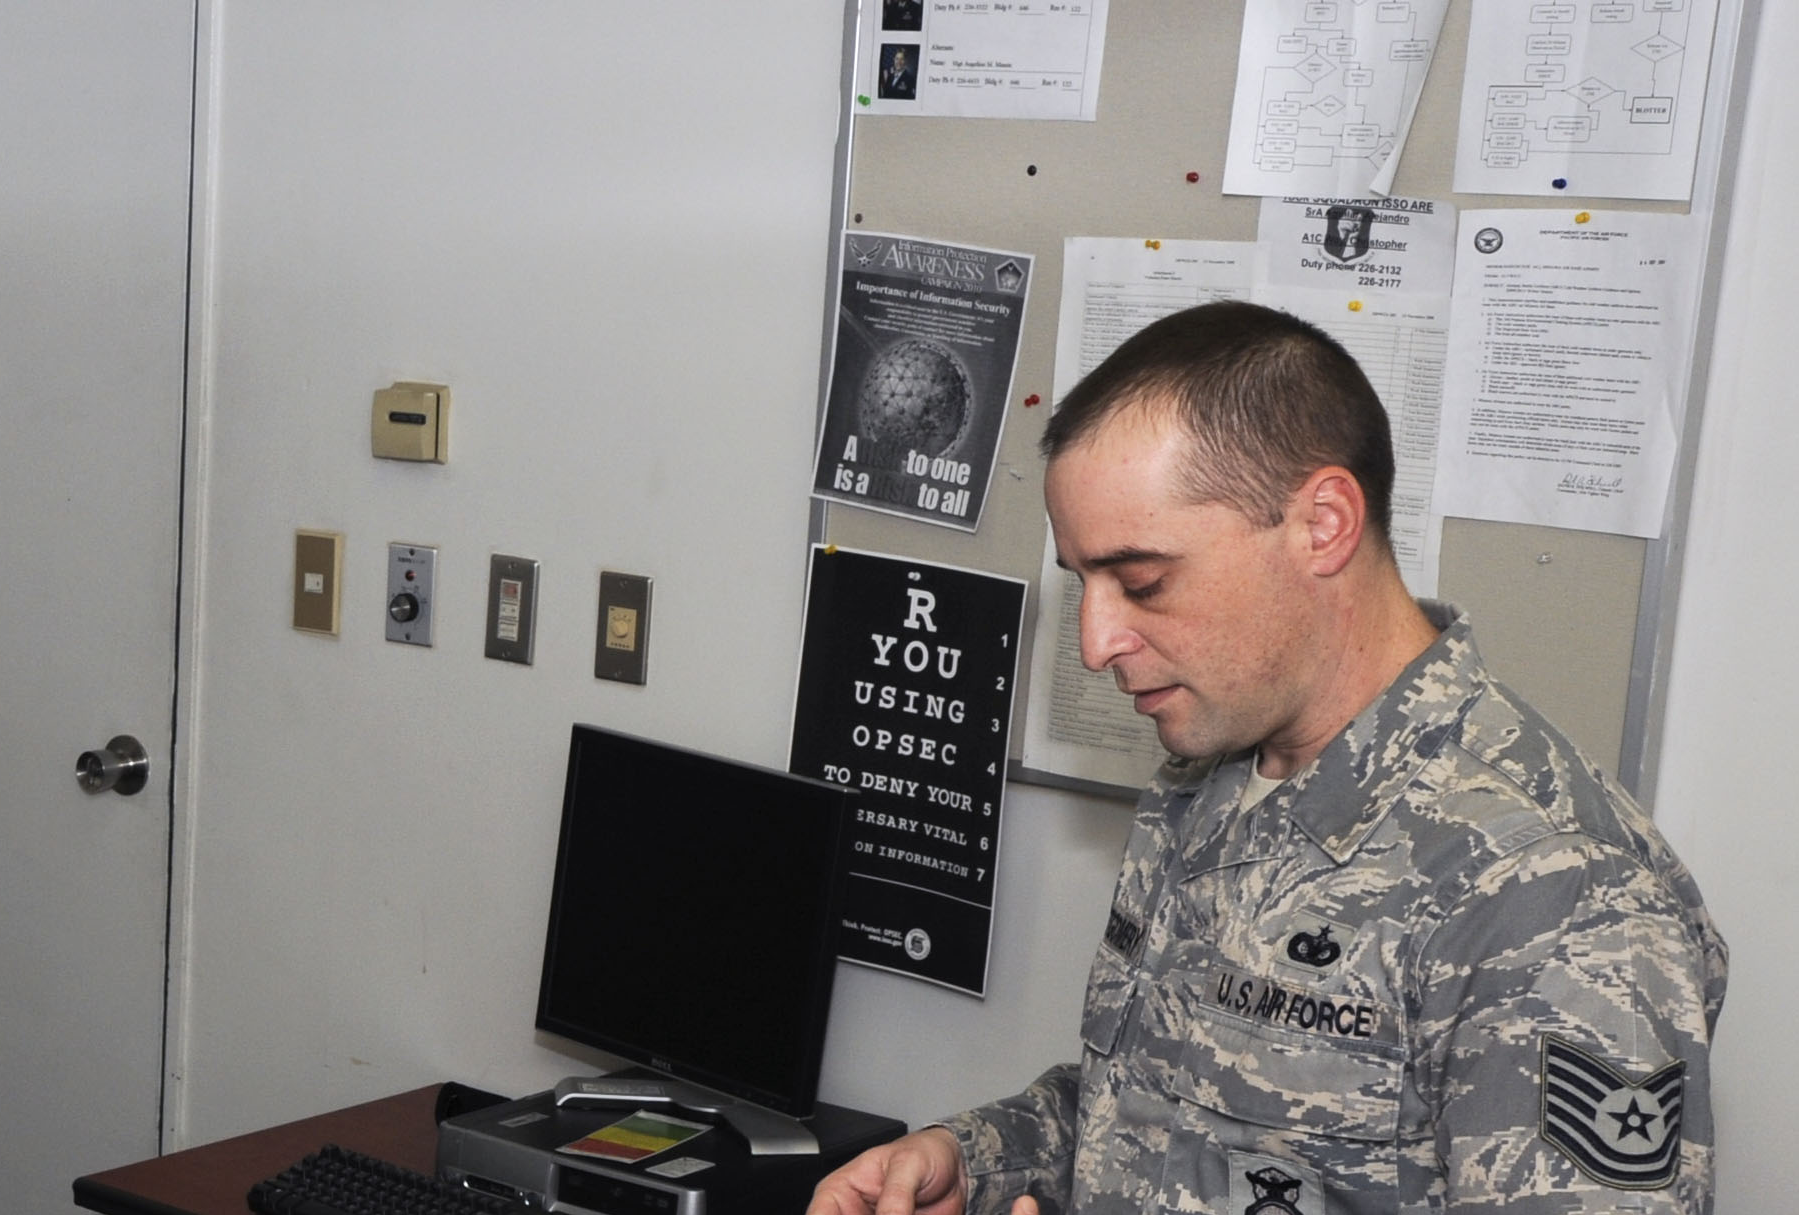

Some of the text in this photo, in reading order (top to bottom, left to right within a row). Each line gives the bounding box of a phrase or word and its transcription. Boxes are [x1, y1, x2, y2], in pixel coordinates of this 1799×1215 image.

[1305, 207, 1323, 217] SrA
[1381, 197, 1408, 210] ISSO
[1410, 200, 1434, 212] ARE
[1302, 233, 1323, 243] A1C
[898, 240, 944, 257] Information
[1301, 258, 1323, 271] Duty
[1358, 263, 1402, 275] 226-2132
[1358, 276, 1402, 288] 226-2177
[856, 280, 1011, 317] Importance of Information Security
[842, 434, 858, 463] A
[906, 448, 929, 477] to
[930, 456, 972, 486] one
[833, 463, 854, 492] is
[855, 472, 870, 496] a
[917, 482, 940, 511] to
[940, 488, 971, 518] all
[903, 587, 938, 633] R
[1001, 633, 1009, 648] 1
[871, 633, 962, 680] YOU
[995, 676, 1005, 691] 2
[854, 680, 965, 724] USING
[991, 718, 1000, 733] 3
[852, 725, 957, 766] OPSEC
[986, 762, 997, 776] 4
[823, 764, 973, 813] TO DENY YOUR
[983, 802, 992, 817] 5
[923, 822, 968, 847] VITAL
[979, 836, 989, 851] 6
[878, 845, 970, 878] INFORMATION
[976, 867, 986, 882] 7
[1216, 972, 1375, 1038] U.S. AIR FORCE
